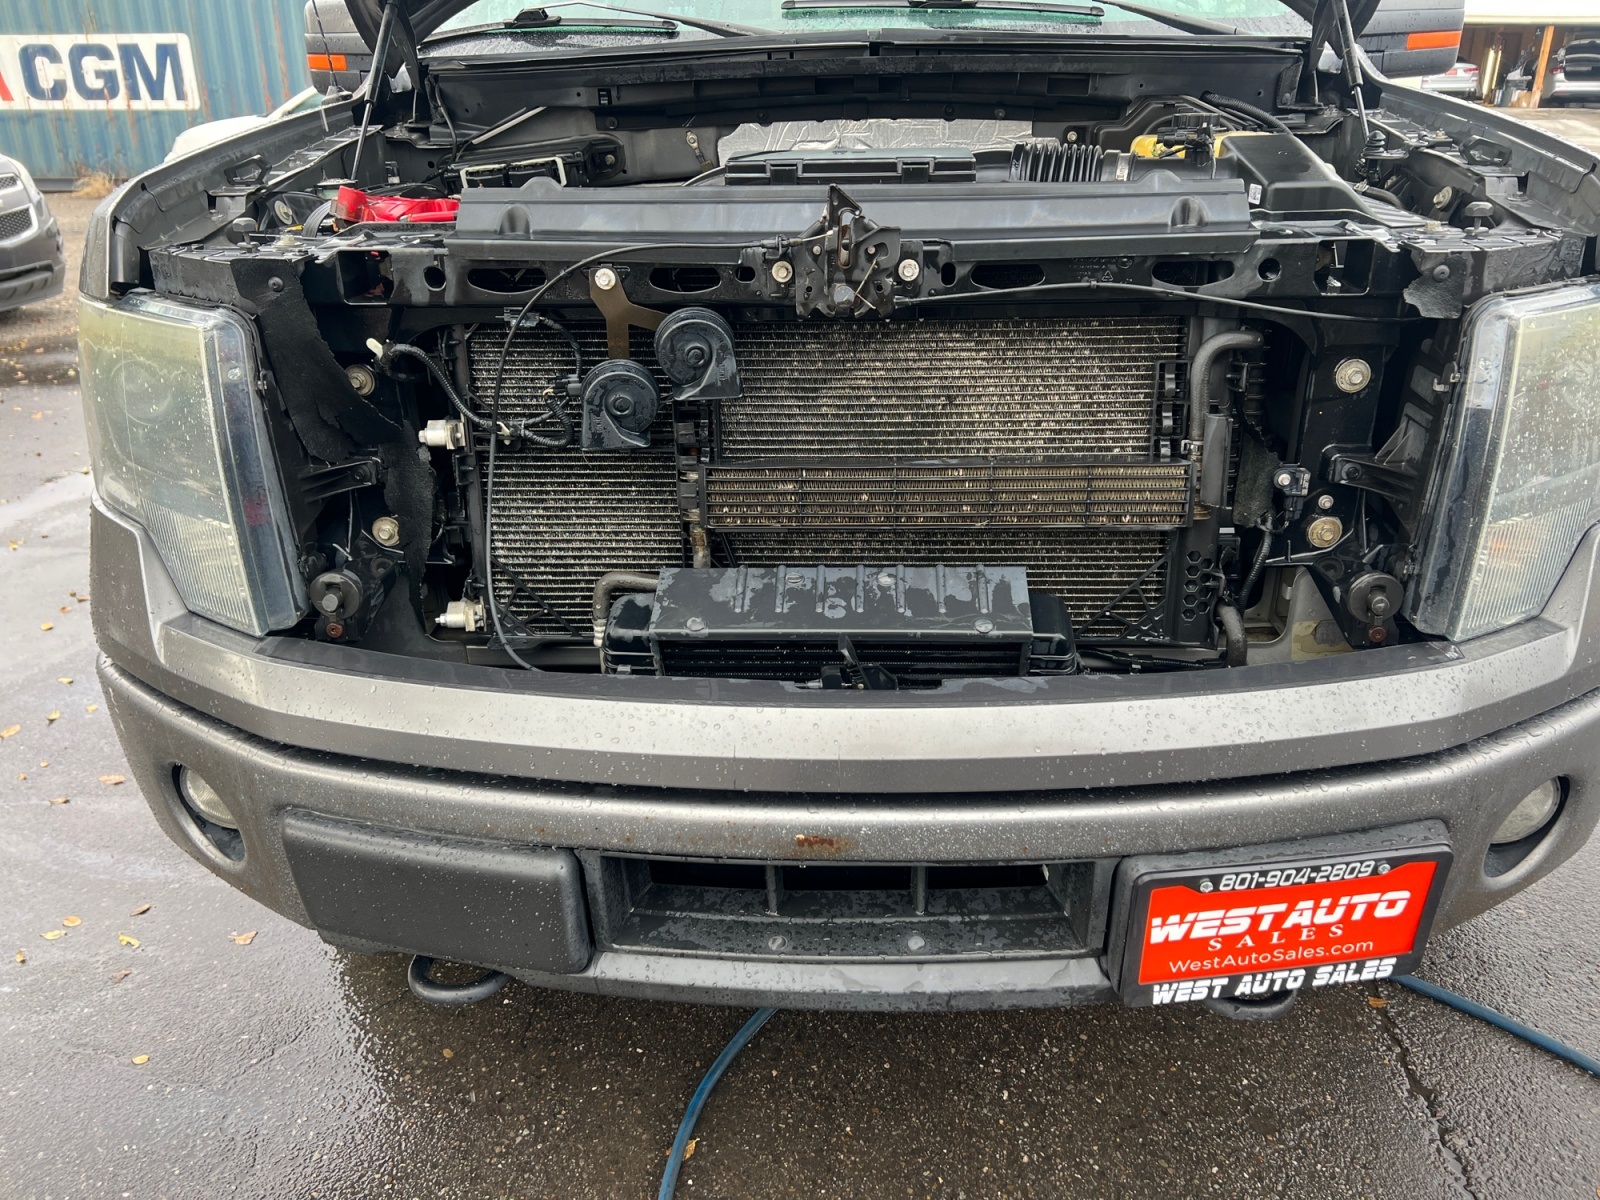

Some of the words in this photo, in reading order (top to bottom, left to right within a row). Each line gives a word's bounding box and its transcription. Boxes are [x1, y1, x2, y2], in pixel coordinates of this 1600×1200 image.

[18, 43, 187, 101] CGM
[1219, 860, 1376, 891] 801-904-2809
[1207, 924, 1344, 952] SALES
[1168, 941, 1374, 974] WestAutoSales.com
[1152, 977, 1229, 1005] WEST
[1234, 968, 1307, 997] AUTO
[1311, 957, 1398, 987] SALES
